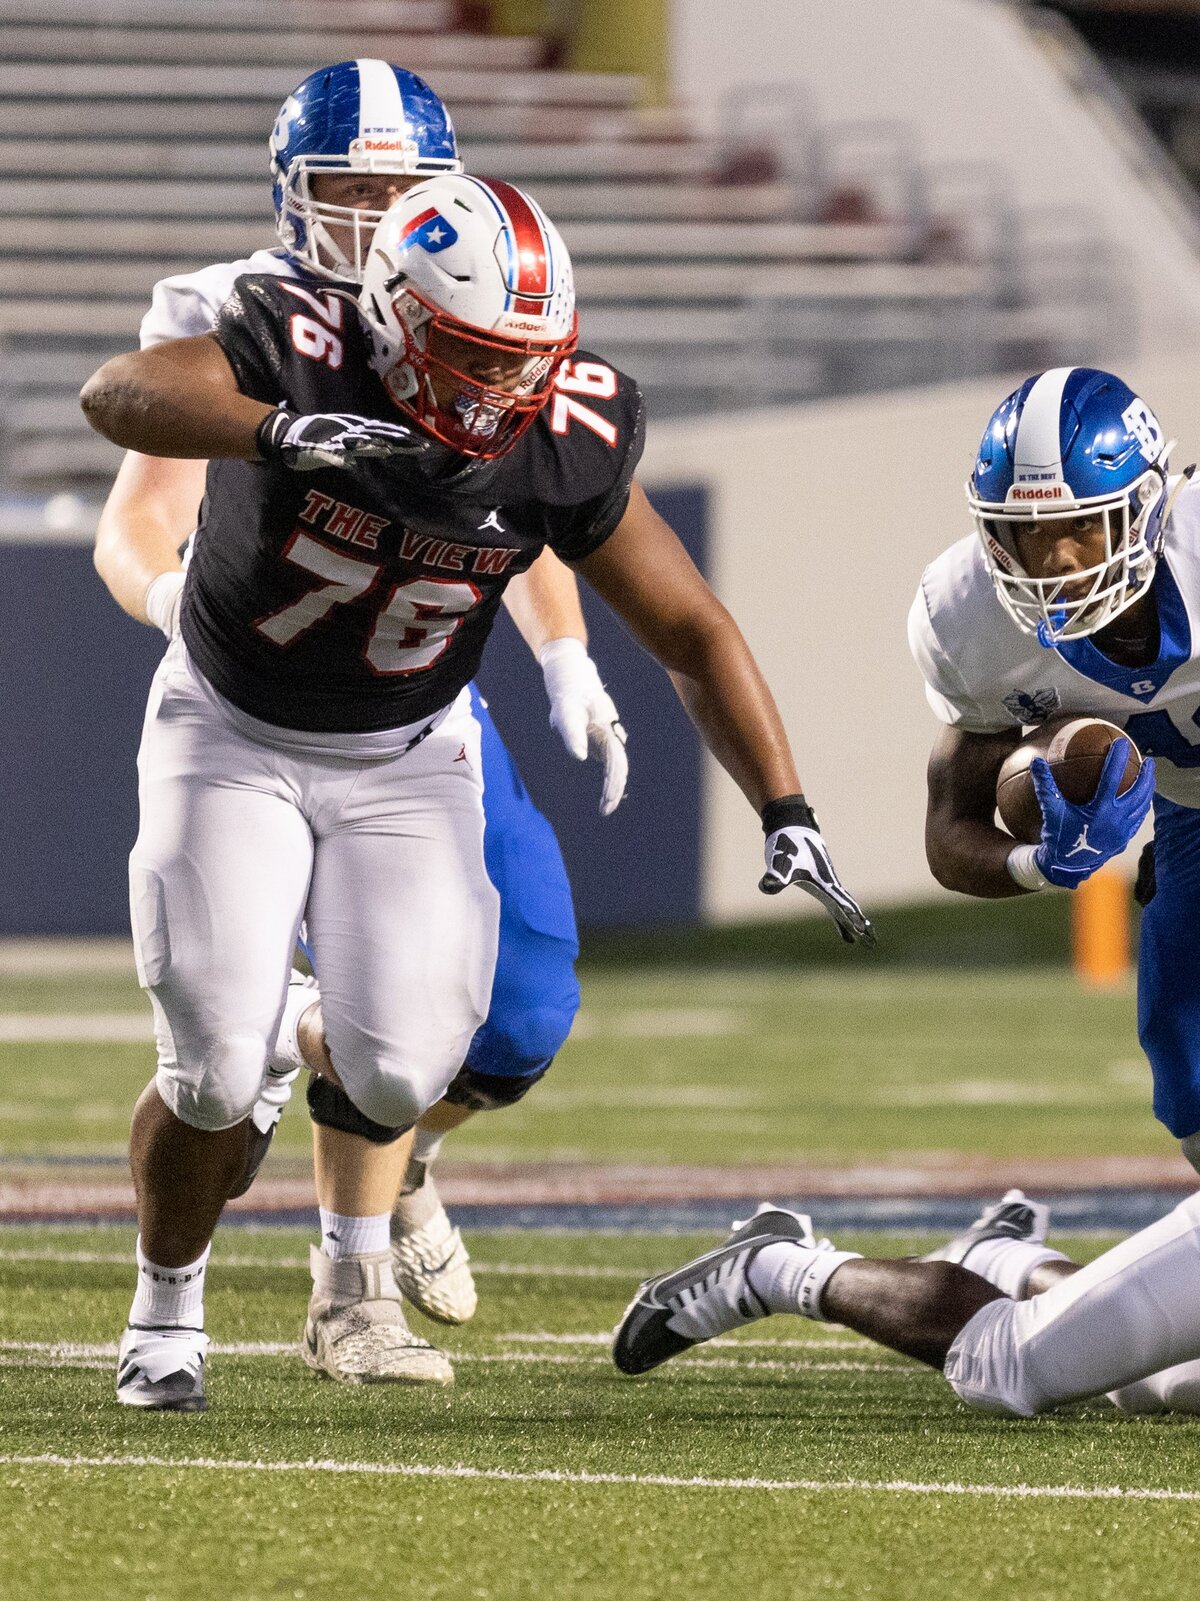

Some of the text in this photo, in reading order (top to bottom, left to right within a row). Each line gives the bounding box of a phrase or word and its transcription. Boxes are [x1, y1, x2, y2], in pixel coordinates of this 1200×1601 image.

[364, 140, 402, 151] Riddell
[278, 281, 343, 371] 76
[551, 357, 619, 449] 76
[1012, 486, 1063, 500] Riddell
[1028, 473, 1040, 481] THE
[298, 488, 522, 576] THE VIEW
[987, 538, 1012, 569] Ridde
[252, 527, 484, 679] 76
